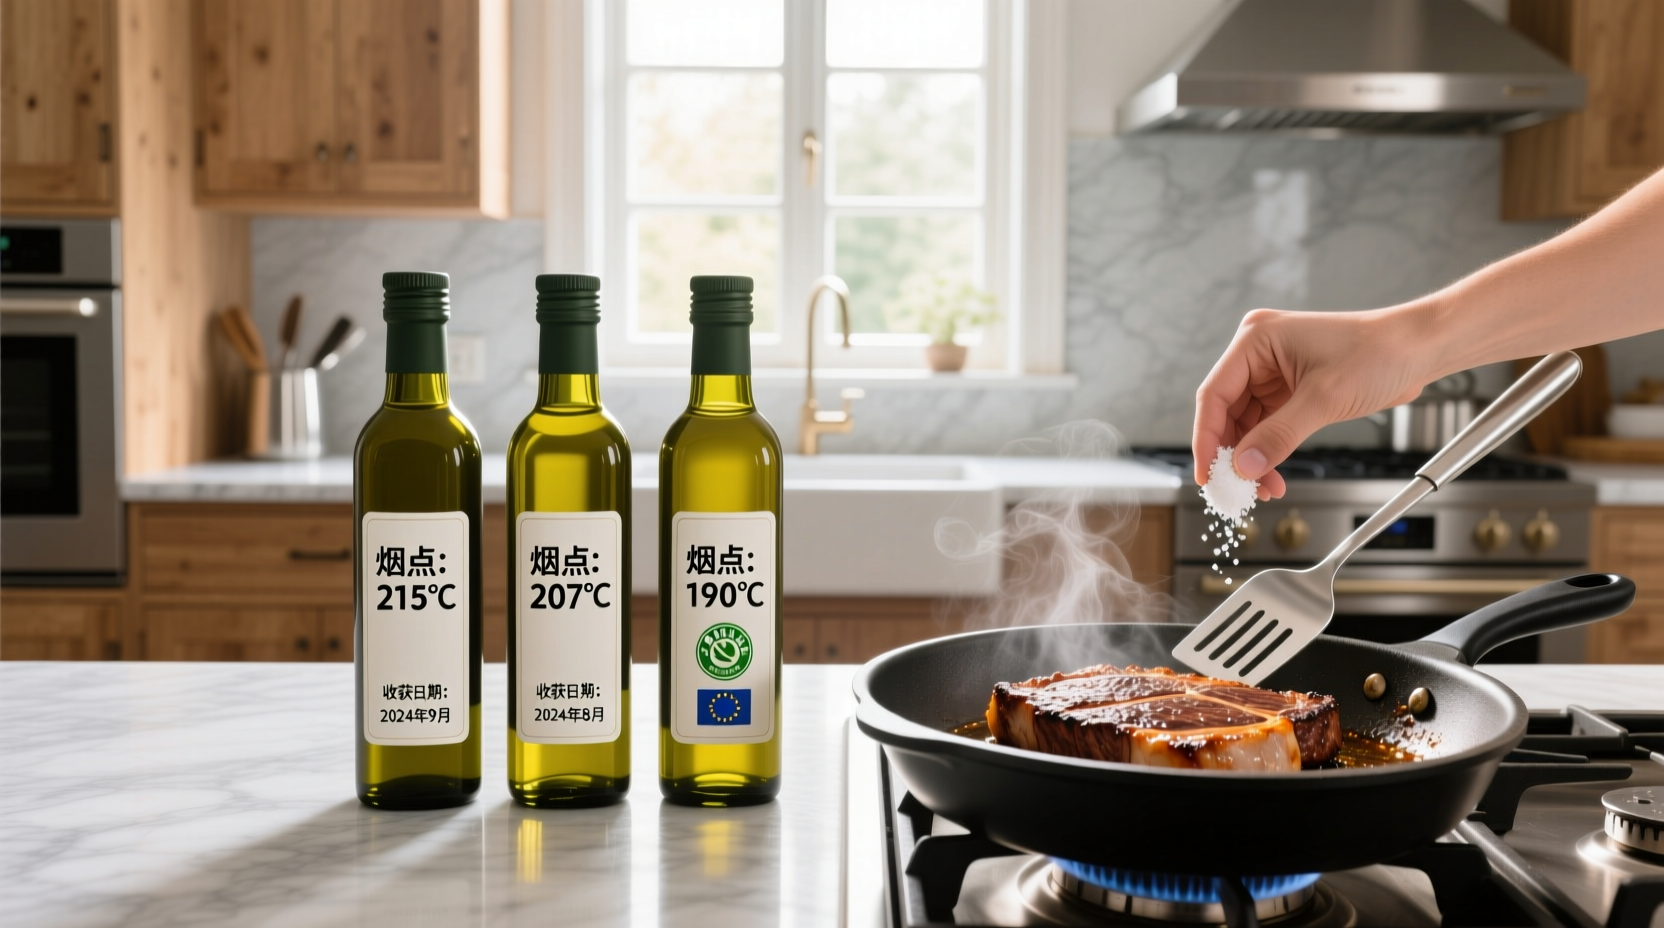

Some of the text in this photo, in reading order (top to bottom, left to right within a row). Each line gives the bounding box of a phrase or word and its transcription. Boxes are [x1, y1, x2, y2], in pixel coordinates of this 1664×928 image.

[376, 546, 446, 577] 烟点：
[530, 546, 599, 577] 烟点：
[686, 545, 754, 575] 烟点：
[377, 584, 457, 610] 215°C
[530, 583, 611, 609] 207°C
[687, 582, 764, 608] 190°C
[380, 708, 450, 723] 2024年9月
[534, 707, 604, 723] 2024年8月
